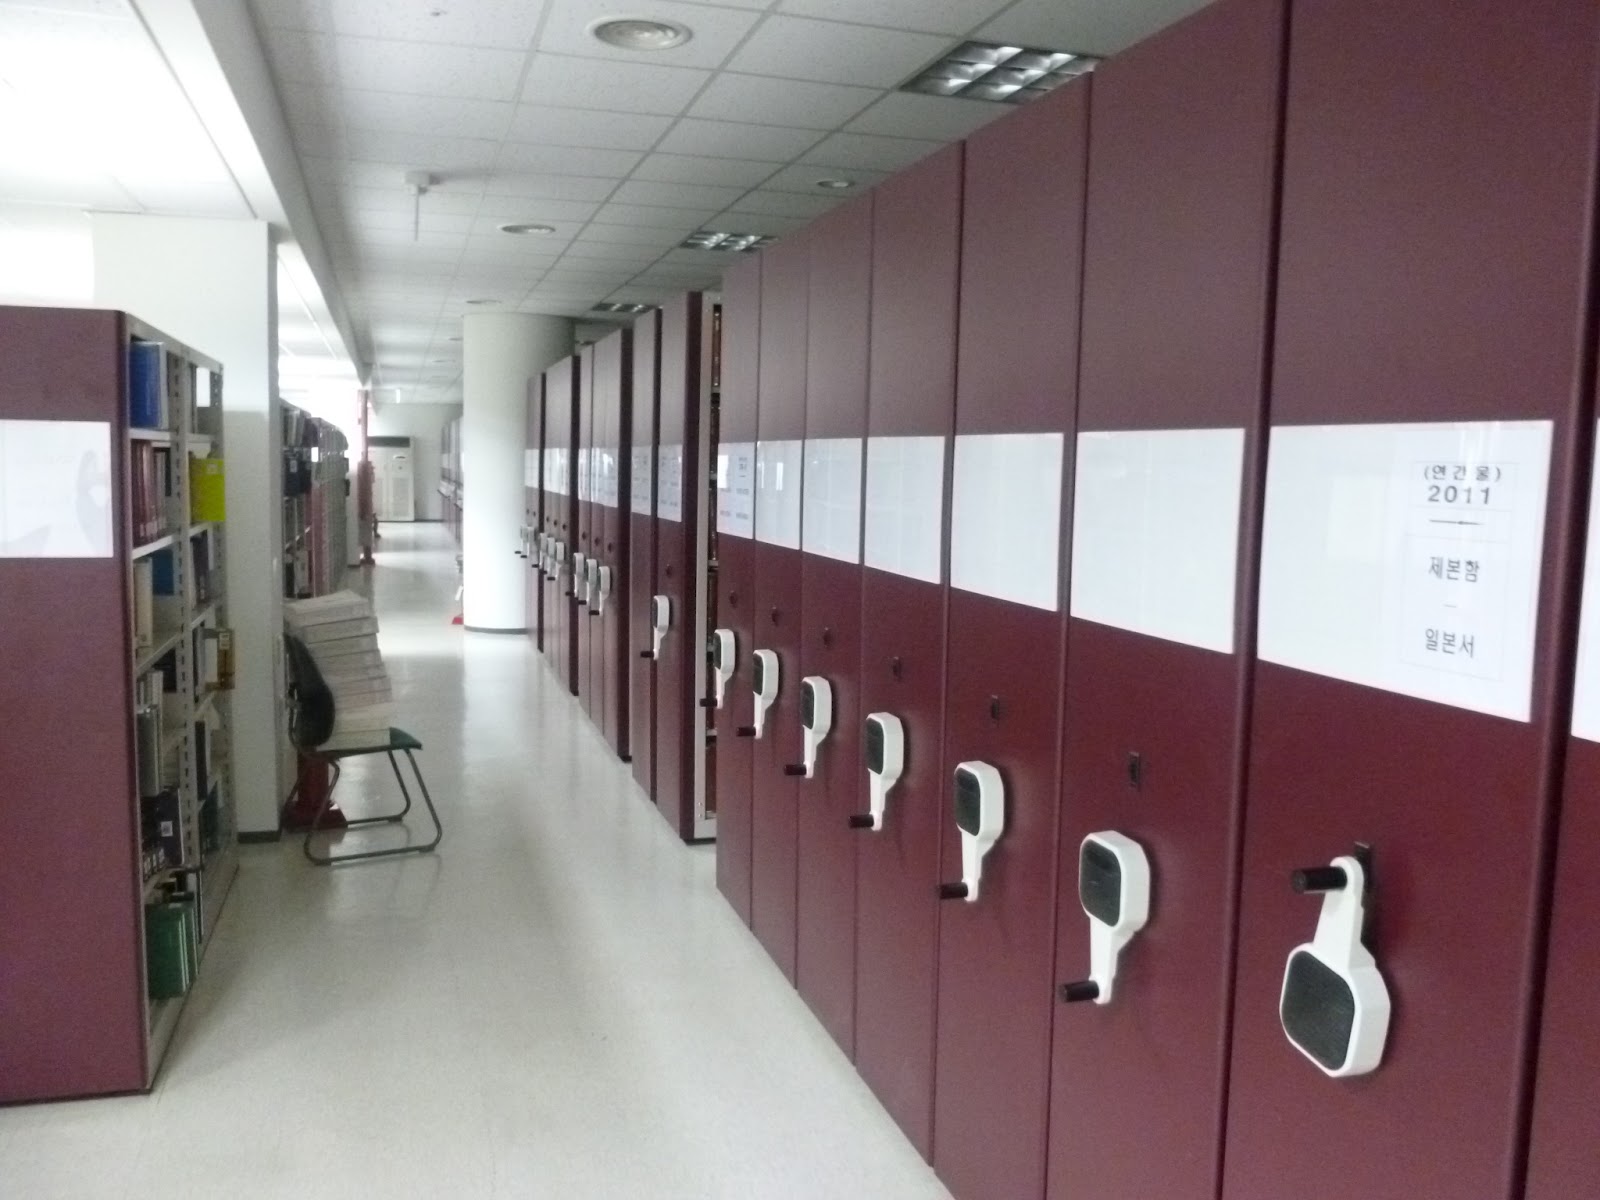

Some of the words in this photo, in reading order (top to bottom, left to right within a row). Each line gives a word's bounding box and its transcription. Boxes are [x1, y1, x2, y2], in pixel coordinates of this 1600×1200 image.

[1427, 485, 1490, 504] 2011
[1428, 556, 1480, 582] 제본함
[1425, 628, 1475, 658] 일본서
